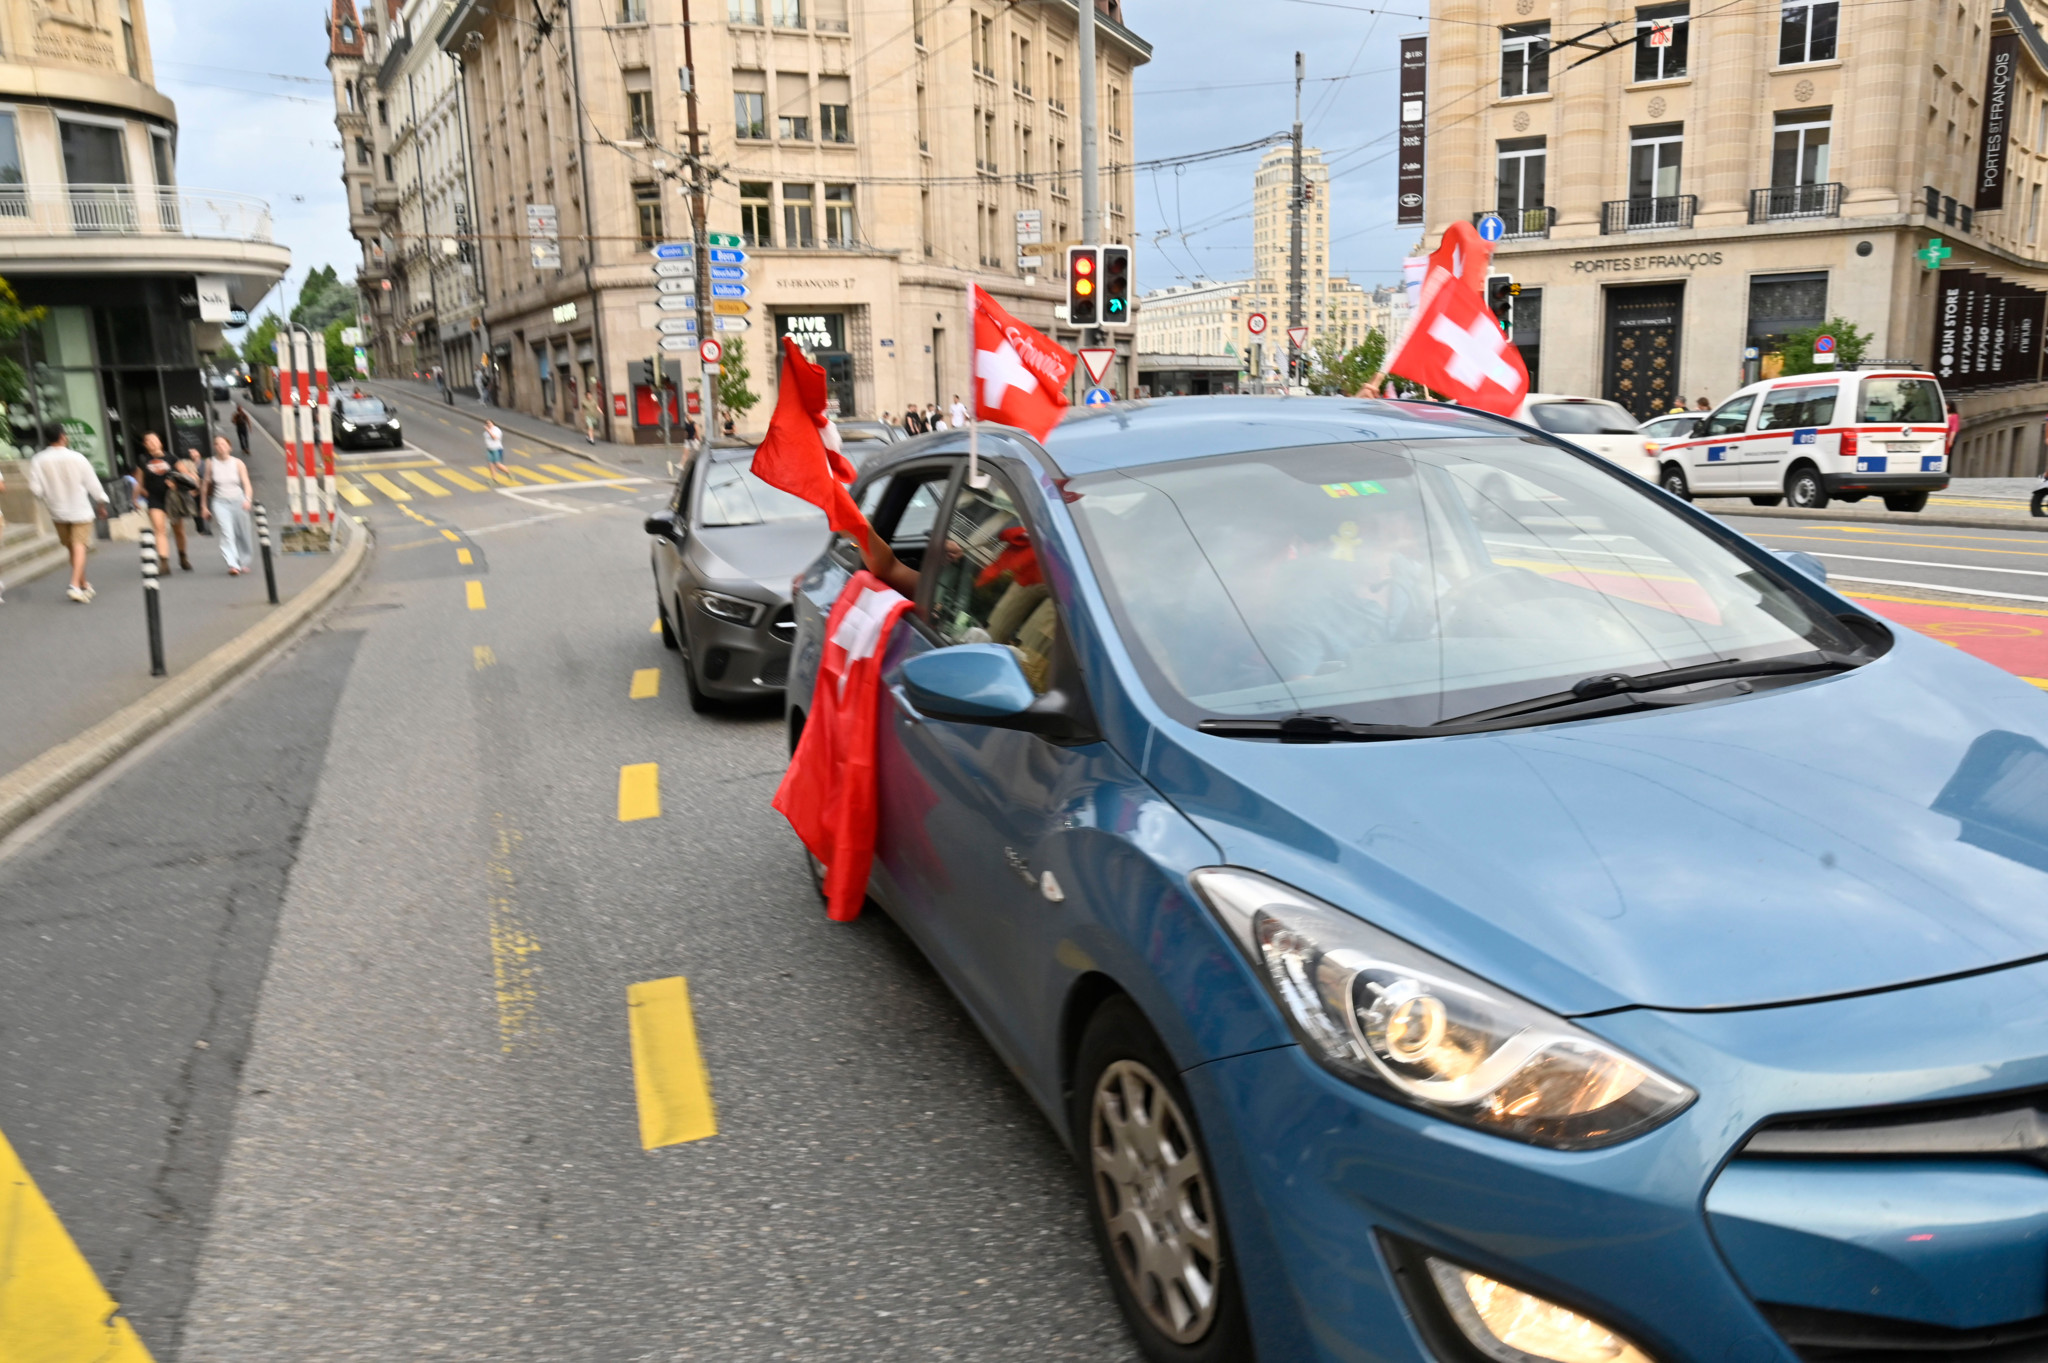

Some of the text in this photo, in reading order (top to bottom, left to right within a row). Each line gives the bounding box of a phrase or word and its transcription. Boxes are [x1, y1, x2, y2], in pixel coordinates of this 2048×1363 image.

[1984, 53, 2011, 187] PORTES ST FRANÇOIS
[1574, 252, 1723, 273] PORTES ST FRANÇOIS
[787, 316, 827, 332] FIVE
[1941, 288, 1959, 354] SUN STORE
